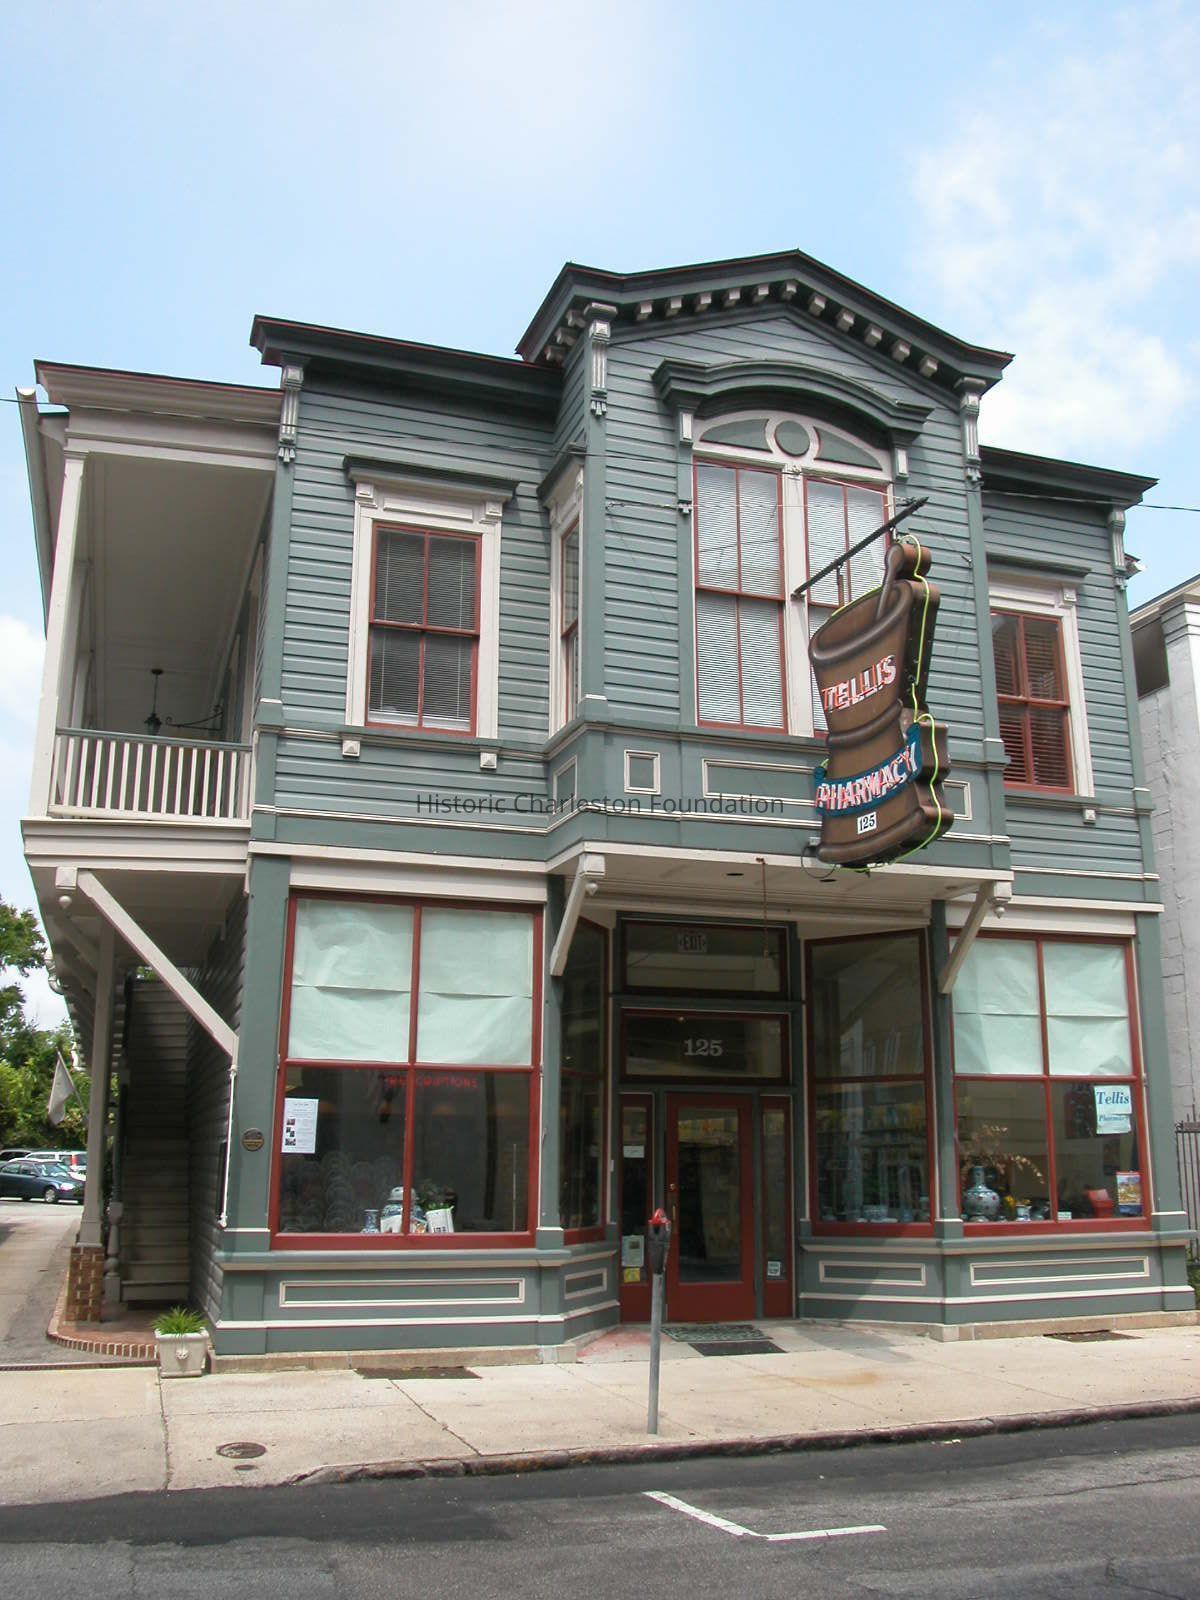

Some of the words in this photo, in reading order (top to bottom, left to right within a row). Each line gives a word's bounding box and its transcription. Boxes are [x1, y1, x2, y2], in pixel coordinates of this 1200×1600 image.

[821, 655, 897, 713] TELLIS
[815, 741, 918, 811] PHARMACY
[859, 814, 876, 831] 125
[684, 1039, 723, 1056] 125
[1097, 1091, 1130, 1105] Tellis
